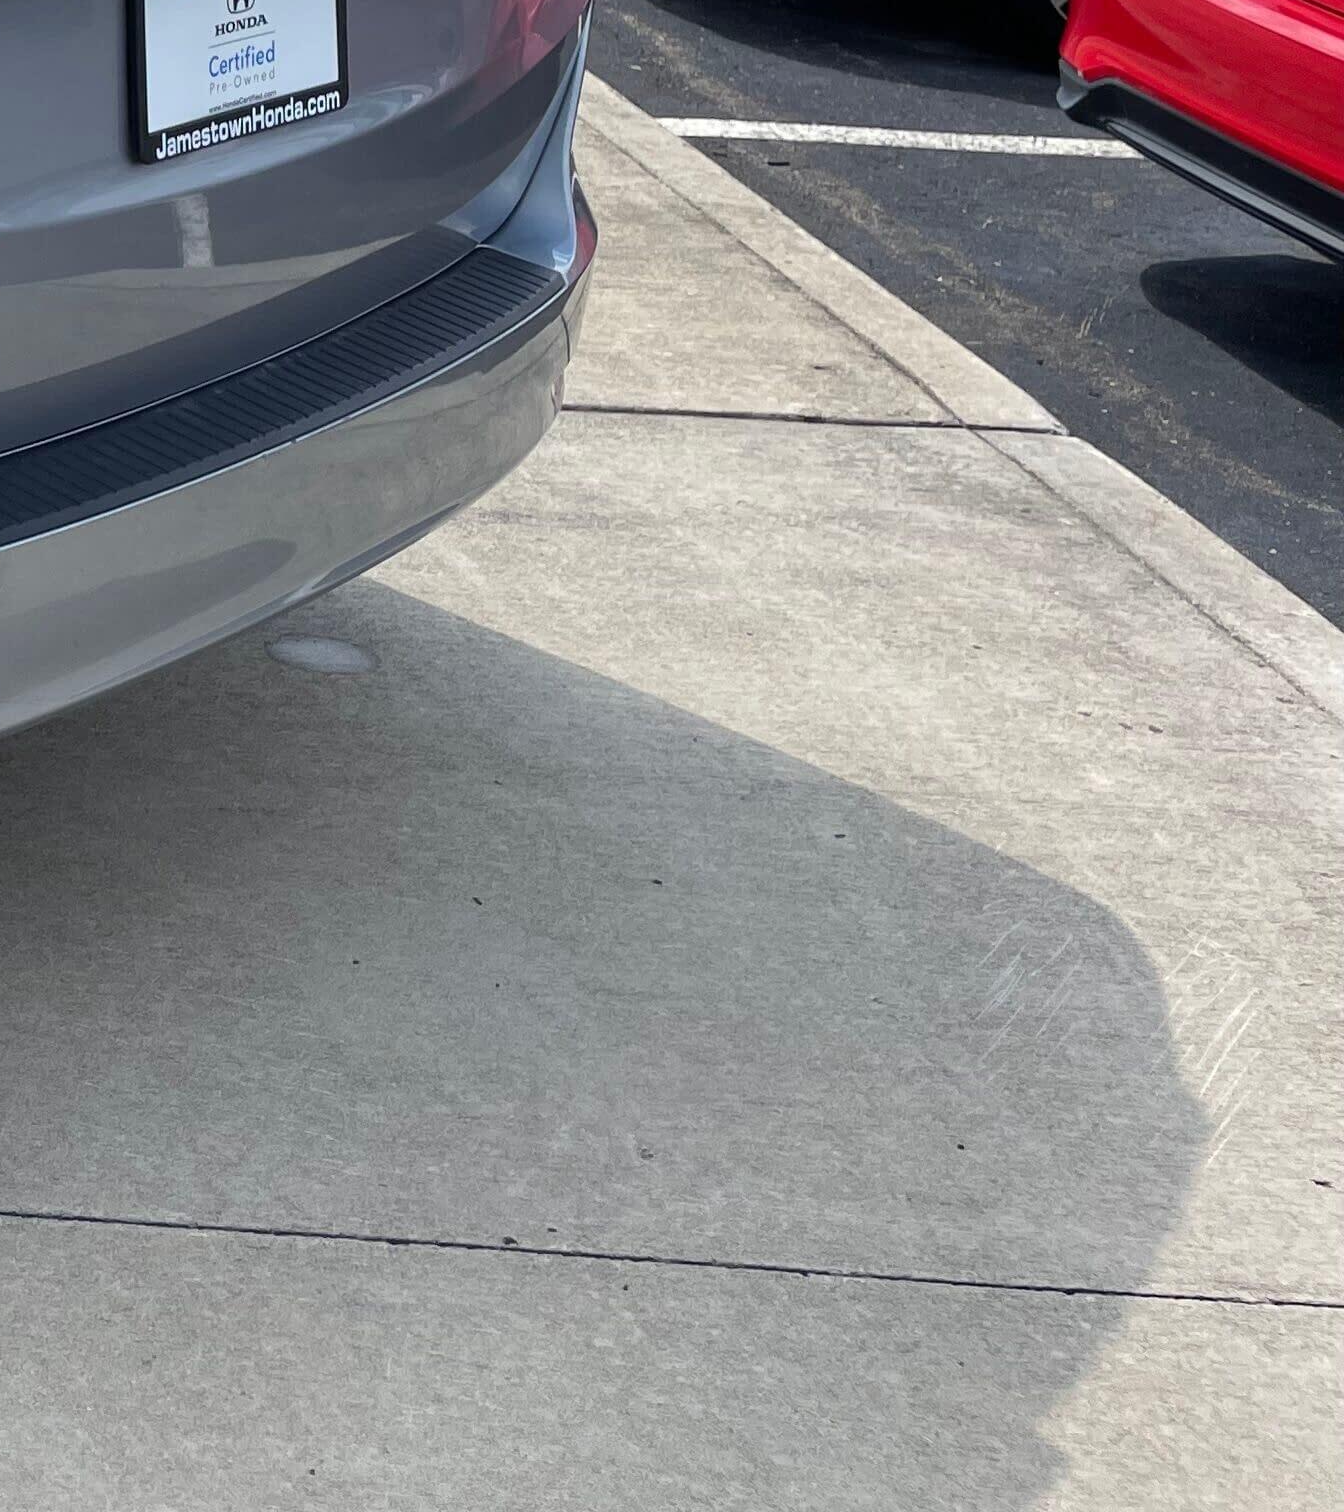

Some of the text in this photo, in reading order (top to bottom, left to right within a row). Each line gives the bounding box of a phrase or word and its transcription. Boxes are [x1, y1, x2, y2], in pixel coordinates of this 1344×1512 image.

[214, 14, 269, 37] HONDA
[208, 40, 276, 78] Certified
[208, 67, 276, 96] Pre-Owned
[155, 89, 342, 161] JamestownHonda.com
